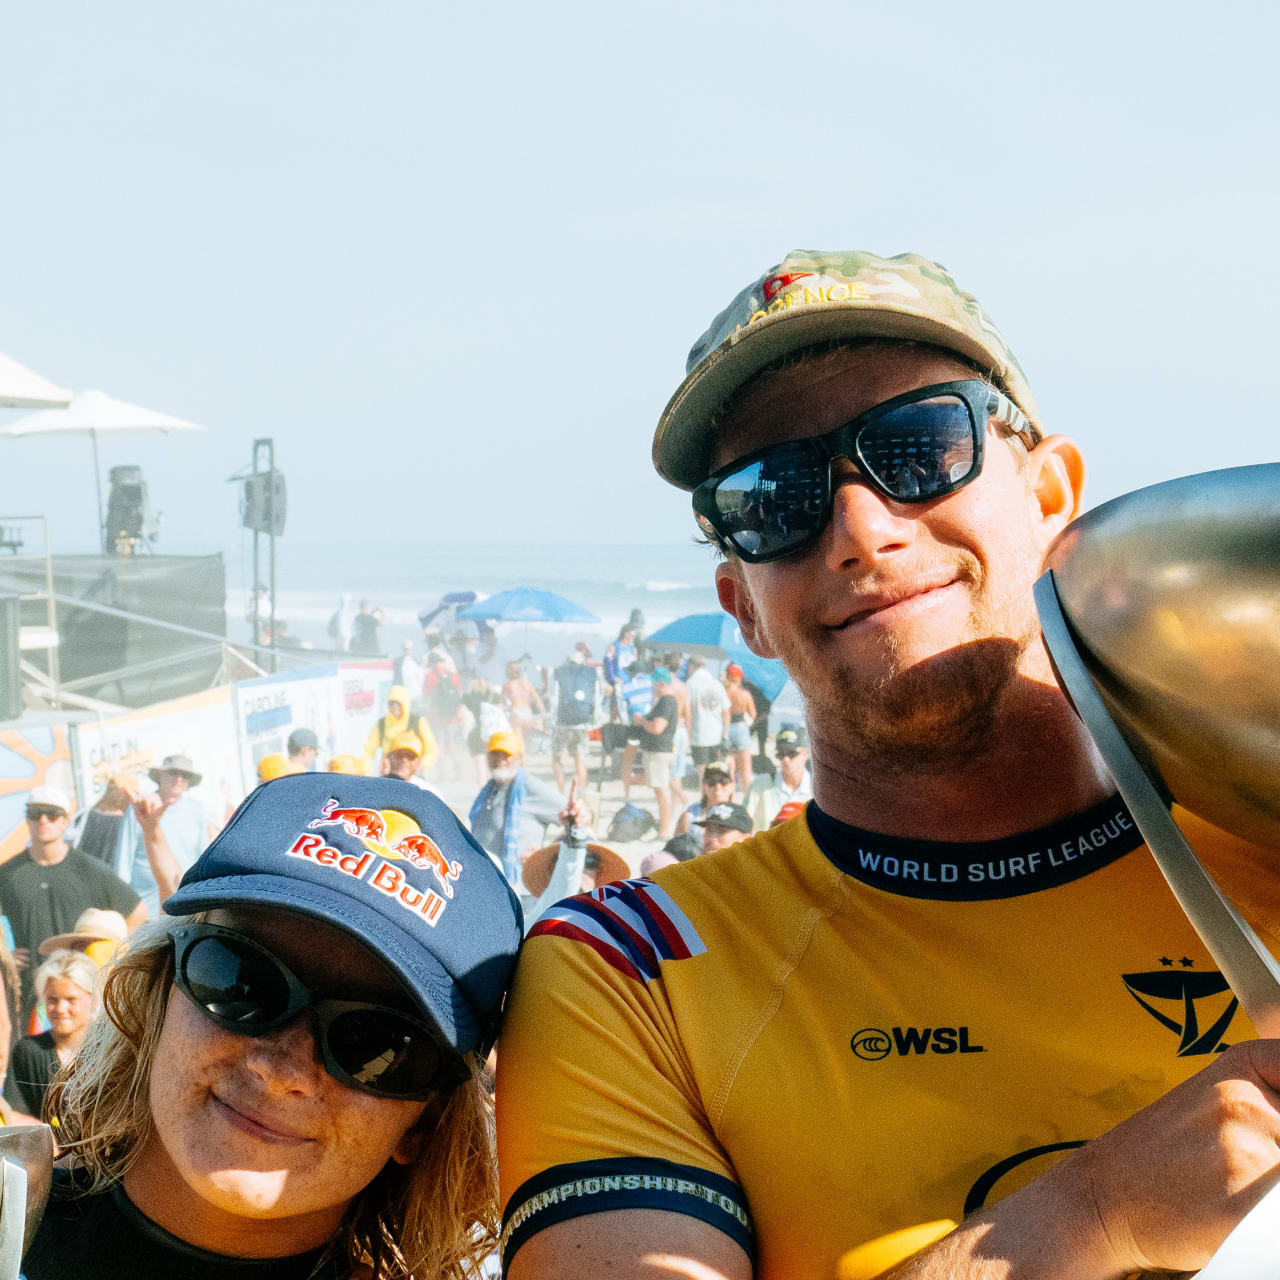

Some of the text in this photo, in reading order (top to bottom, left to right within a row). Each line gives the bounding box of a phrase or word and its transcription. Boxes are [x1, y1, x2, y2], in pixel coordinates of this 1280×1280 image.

[858, 811, 1133, 883] WORLD SURF LEAGUE
[288, 833, 447, 926] Red Bull
[892, 1026, 985, 1056] WSL
[513, 1174, 696, 1229] CHAMPIONSHIP
